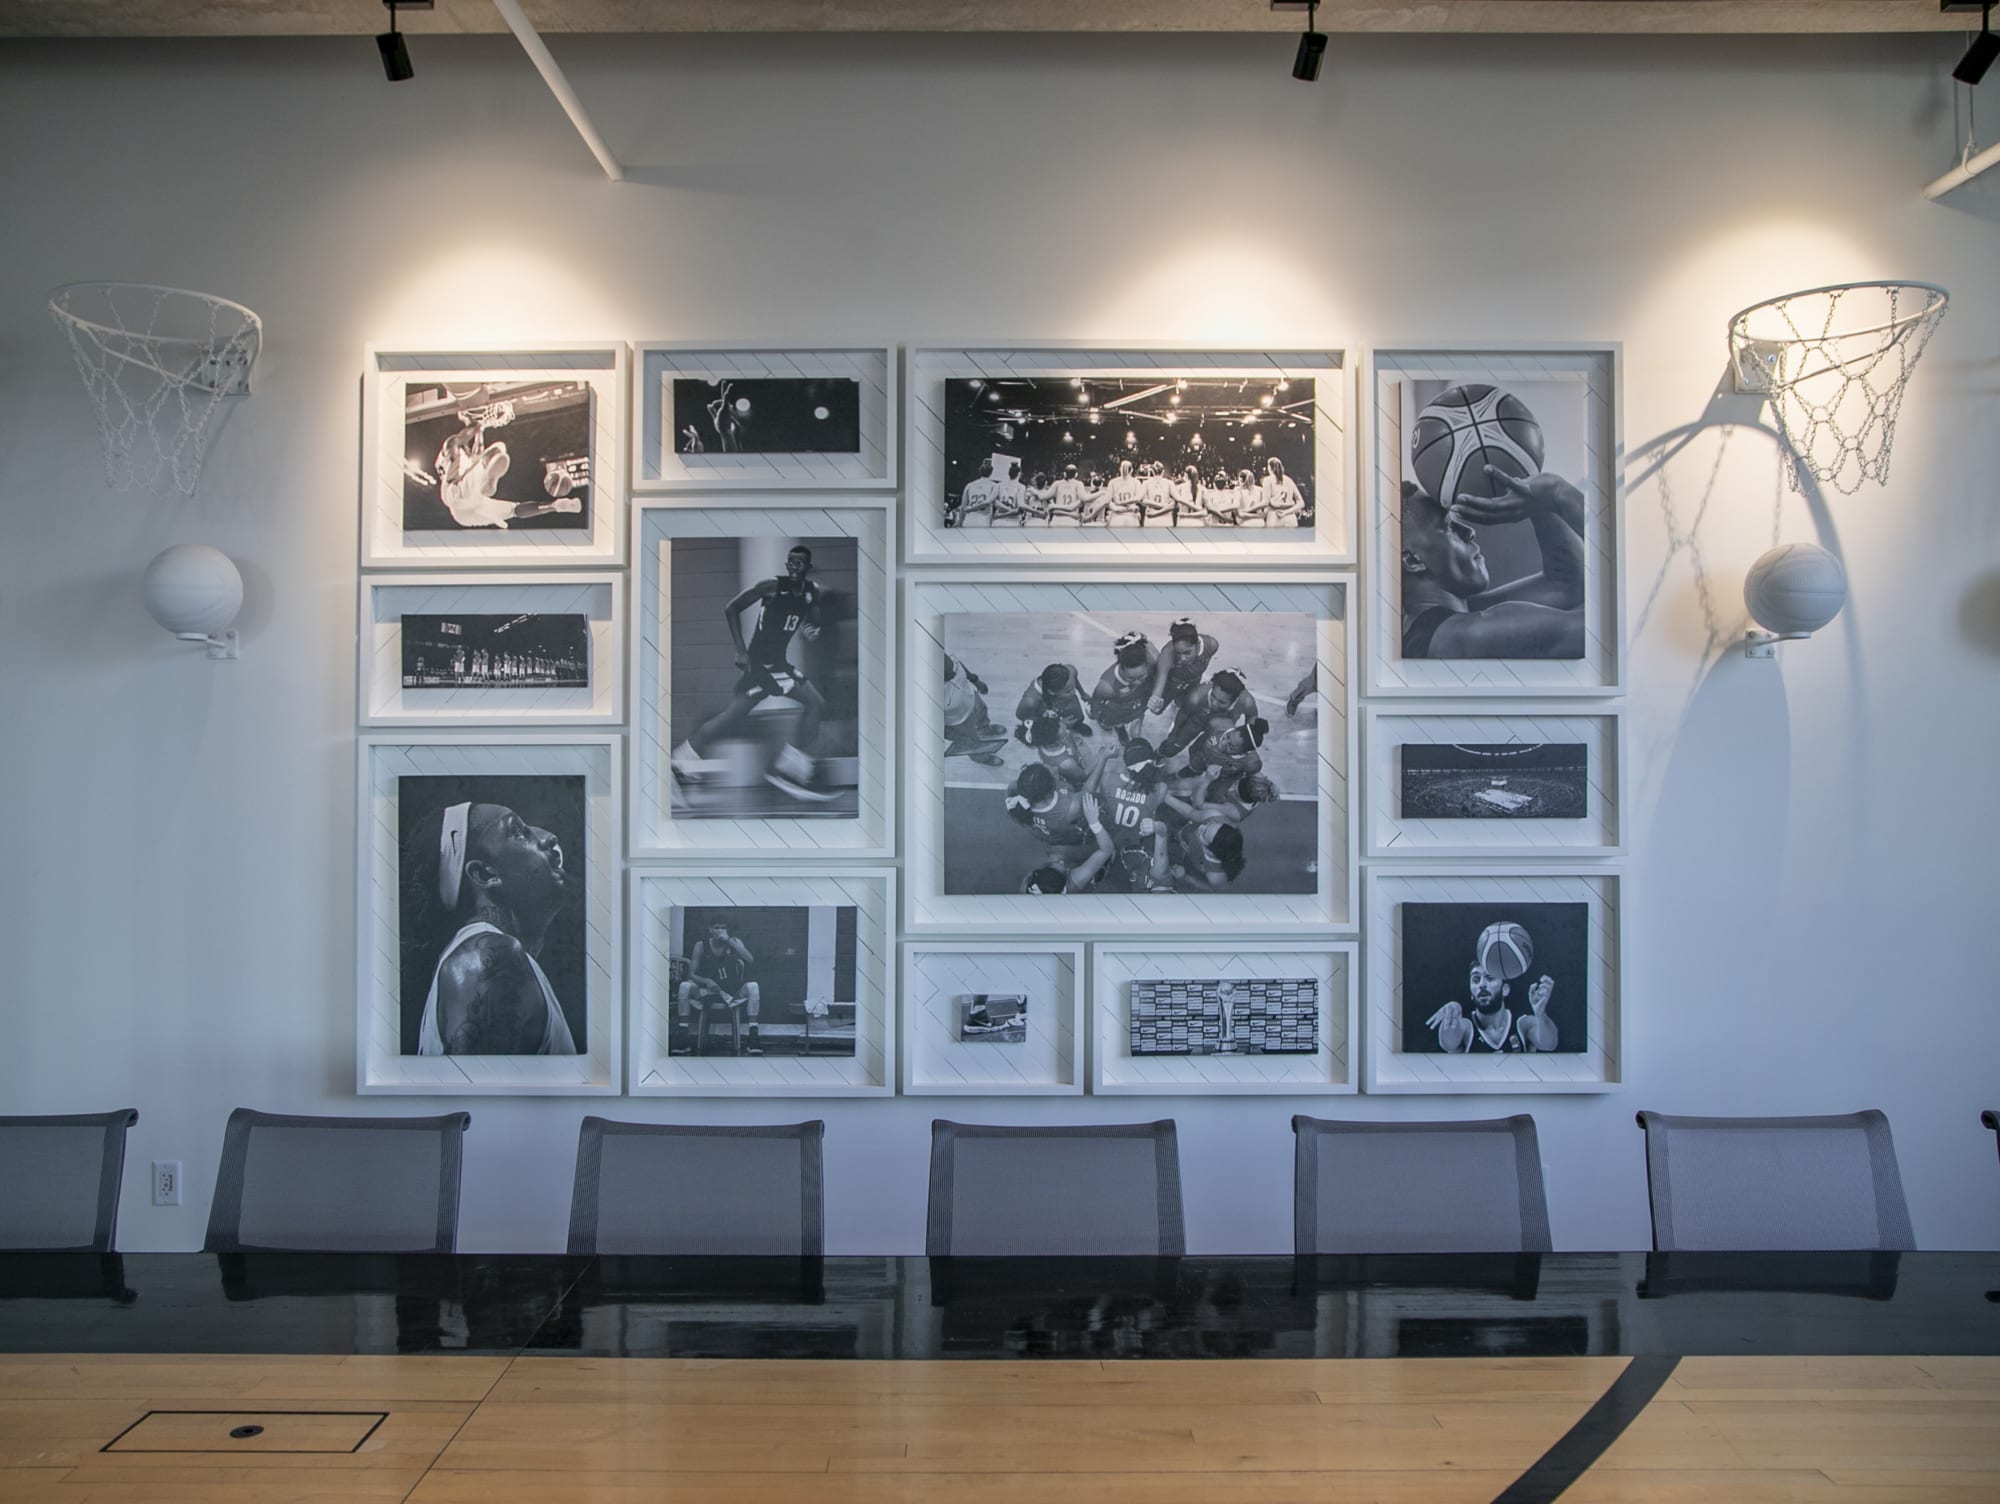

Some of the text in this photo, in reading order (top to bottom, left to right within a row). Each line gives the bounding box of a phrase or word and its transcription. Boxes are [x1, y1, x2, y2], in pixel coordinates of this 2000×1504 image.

[784, 614, 800, 631] 13
[1115, 803, 1140, 827] 10
[718, 967, 728, 980] 11
